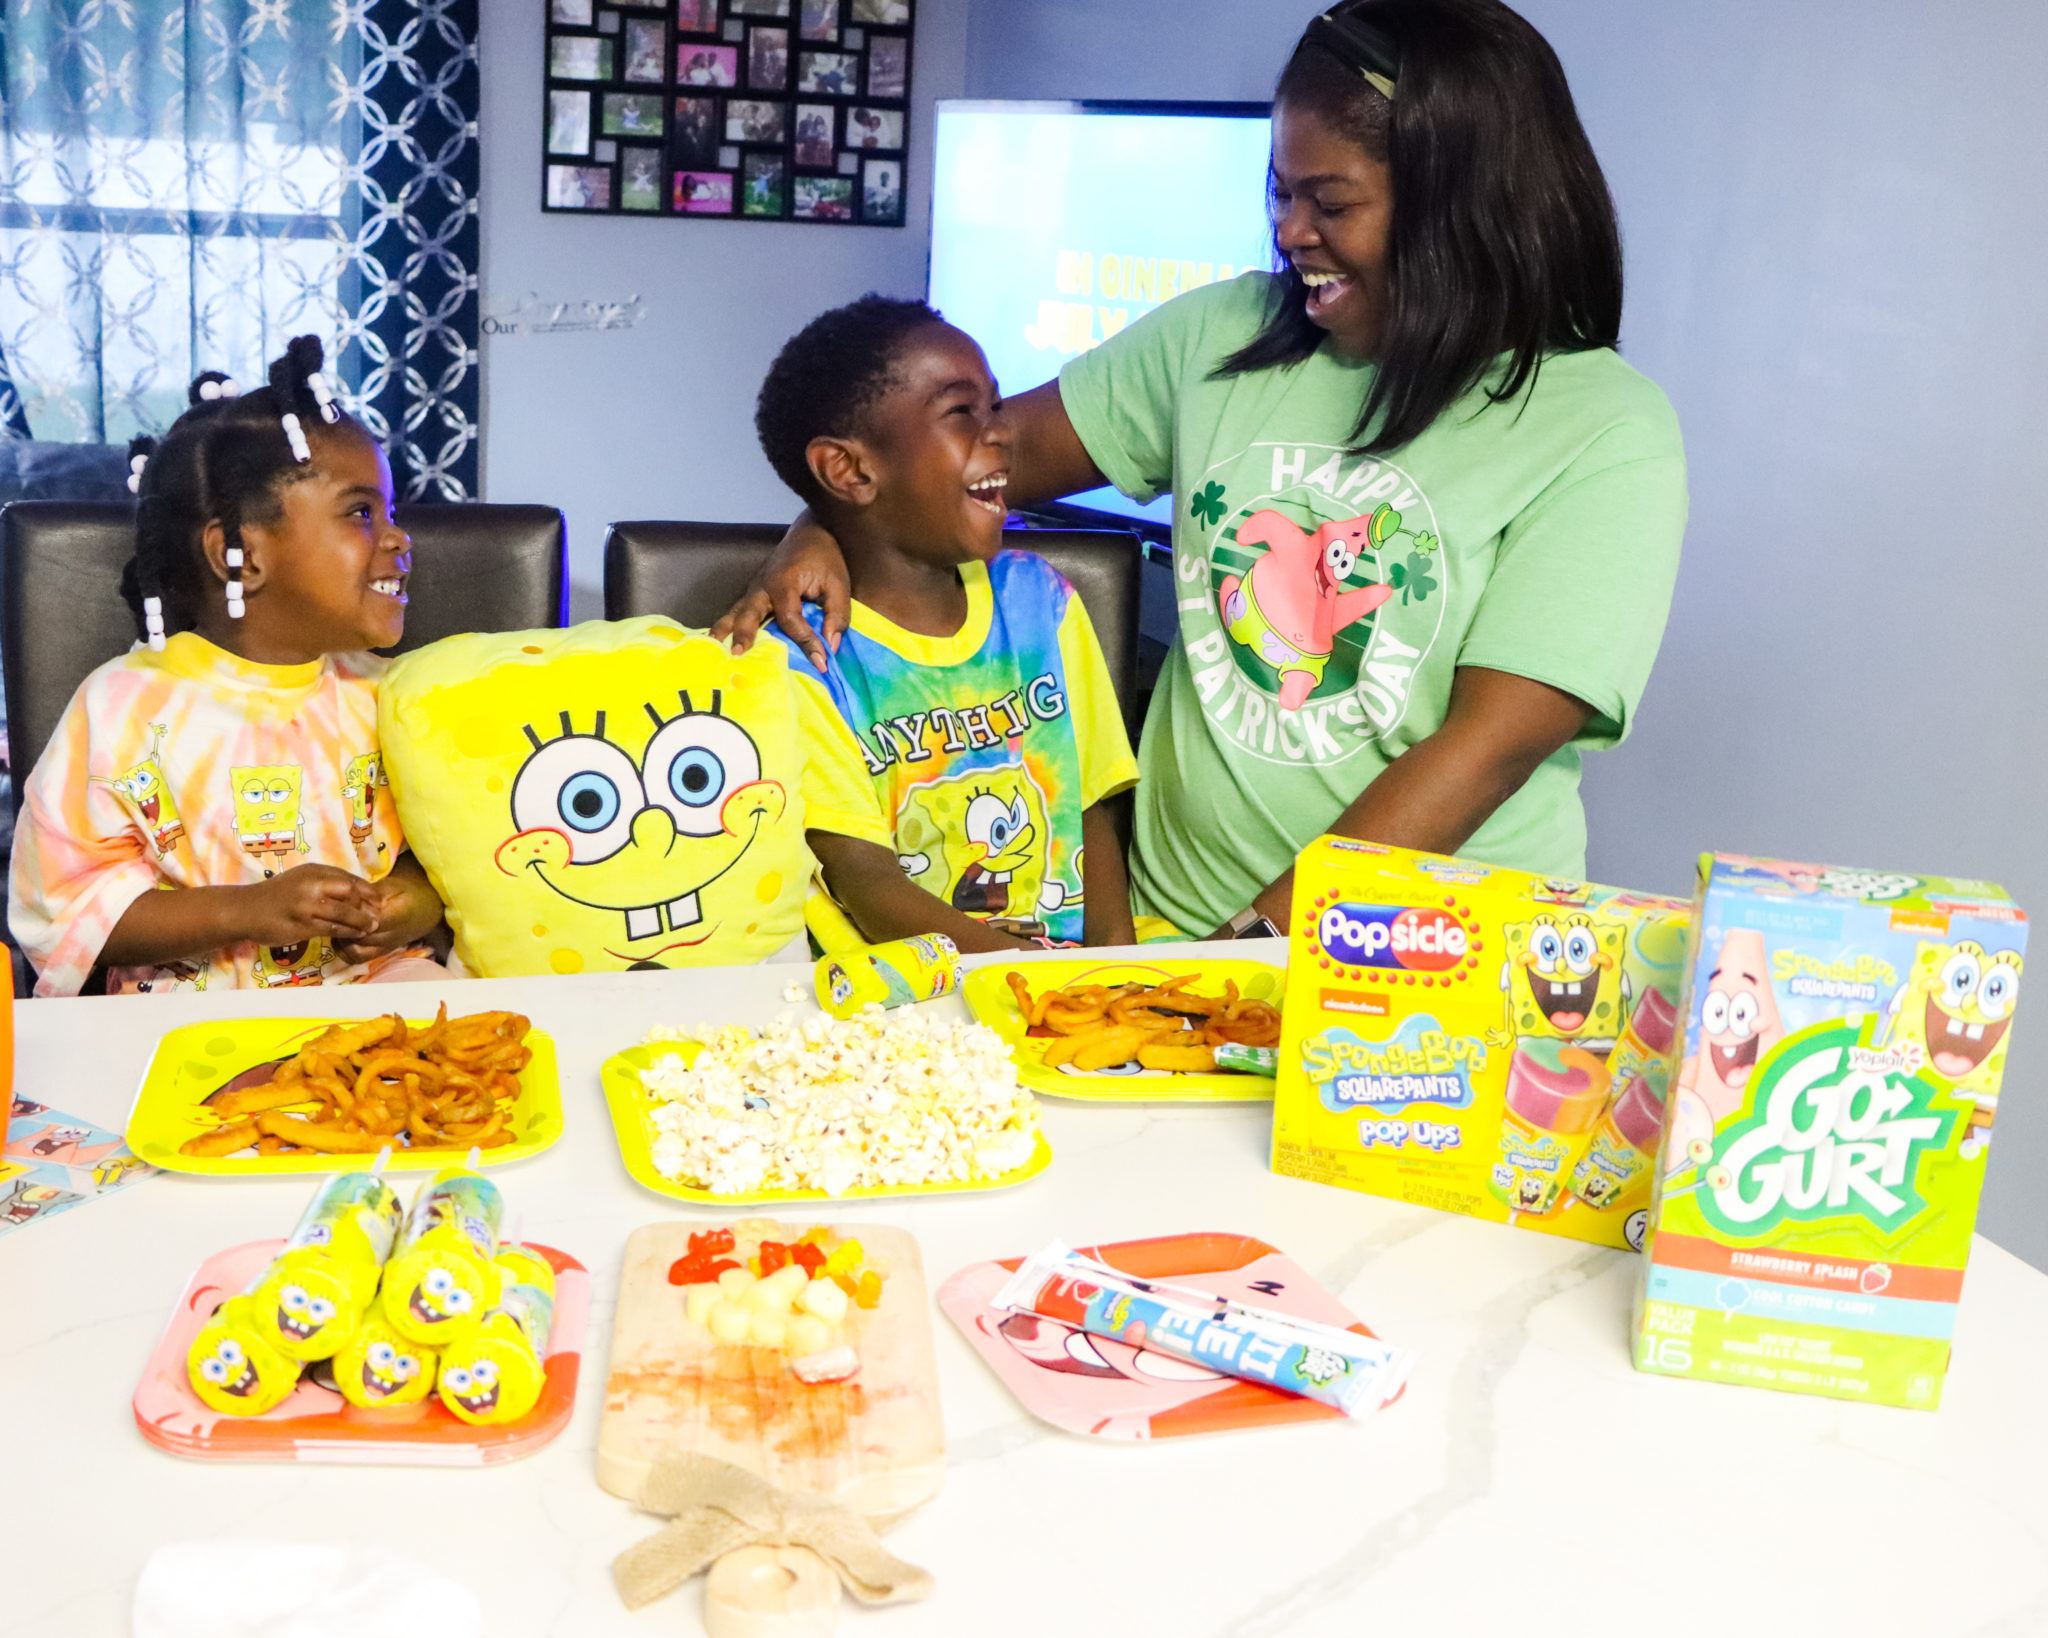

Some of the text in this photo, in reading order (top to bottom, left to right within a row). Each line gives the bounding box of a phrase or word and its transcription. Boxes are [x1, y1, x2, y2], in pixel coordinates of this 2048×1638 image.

[1056, 249, 1093, 296] IN
[482, 318, 517, 335] Our
[1270, 447, 1419, 512] HAPPY
[1178, 553, 1421, 760] ST PATRICK'S DAY
[1321, 908, 1469, 958] Popsicle
[1791, 977, 1876, 1000] SQUAREPANTS
[1323, 998, 1386, 1015] nickelodeon
[1336, 1075, 1462, 1102] SQUAREPANTS
[1713, 1116, 1943, 1224] GURT
[1731, 1252, 1811, 1275] STRAWBERRY
[1813, 1262, 1859, 1280] SPLASH
[1649, 1317, 1694, 1336] PACK
[1650, 1303, 1698, 1322] VALUE
[1642, 1335, 1694, 1371] 16
